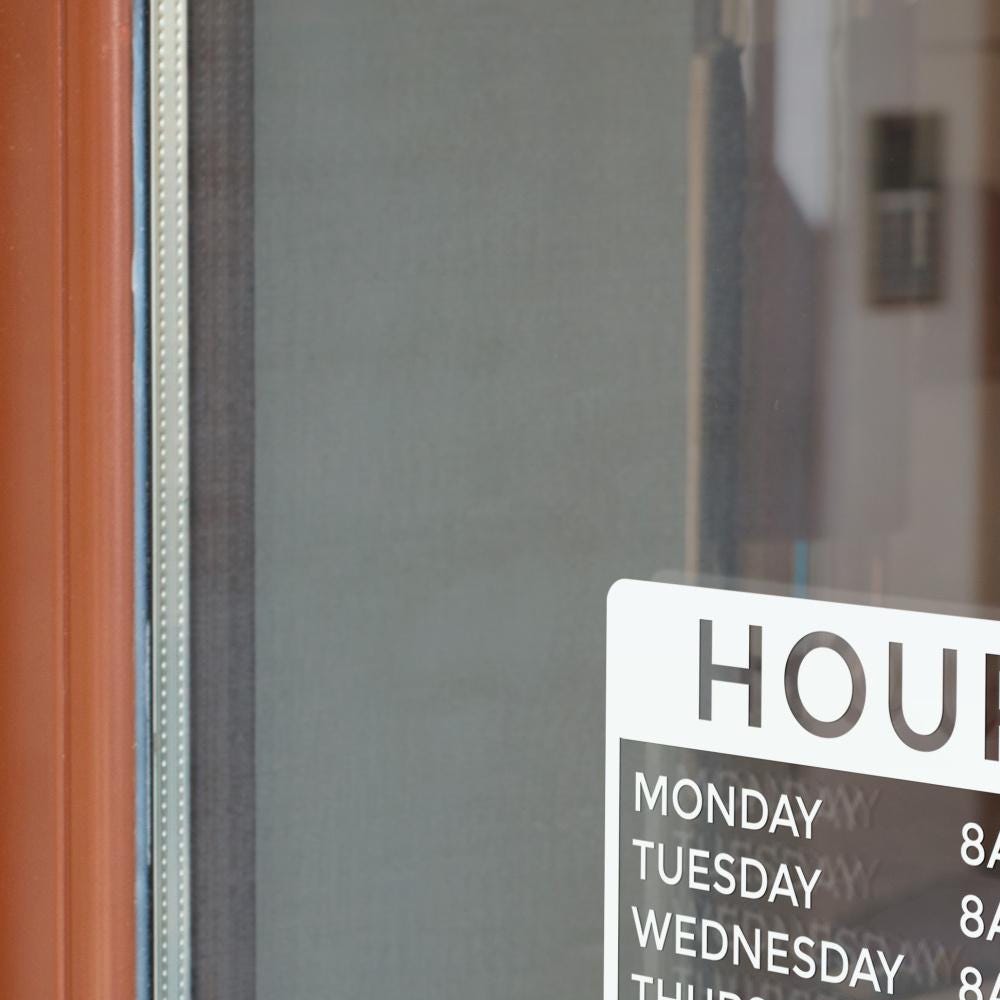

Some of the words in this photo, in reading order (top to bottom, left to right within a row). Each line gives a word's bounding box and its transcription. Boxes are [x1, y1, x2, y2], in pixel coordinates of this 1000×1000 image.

[633, 771, 823, 839] MONDAY
[632, 838, 822, 909] TUESDAY
[631, 906, 905, 995] WEDNESDAY
